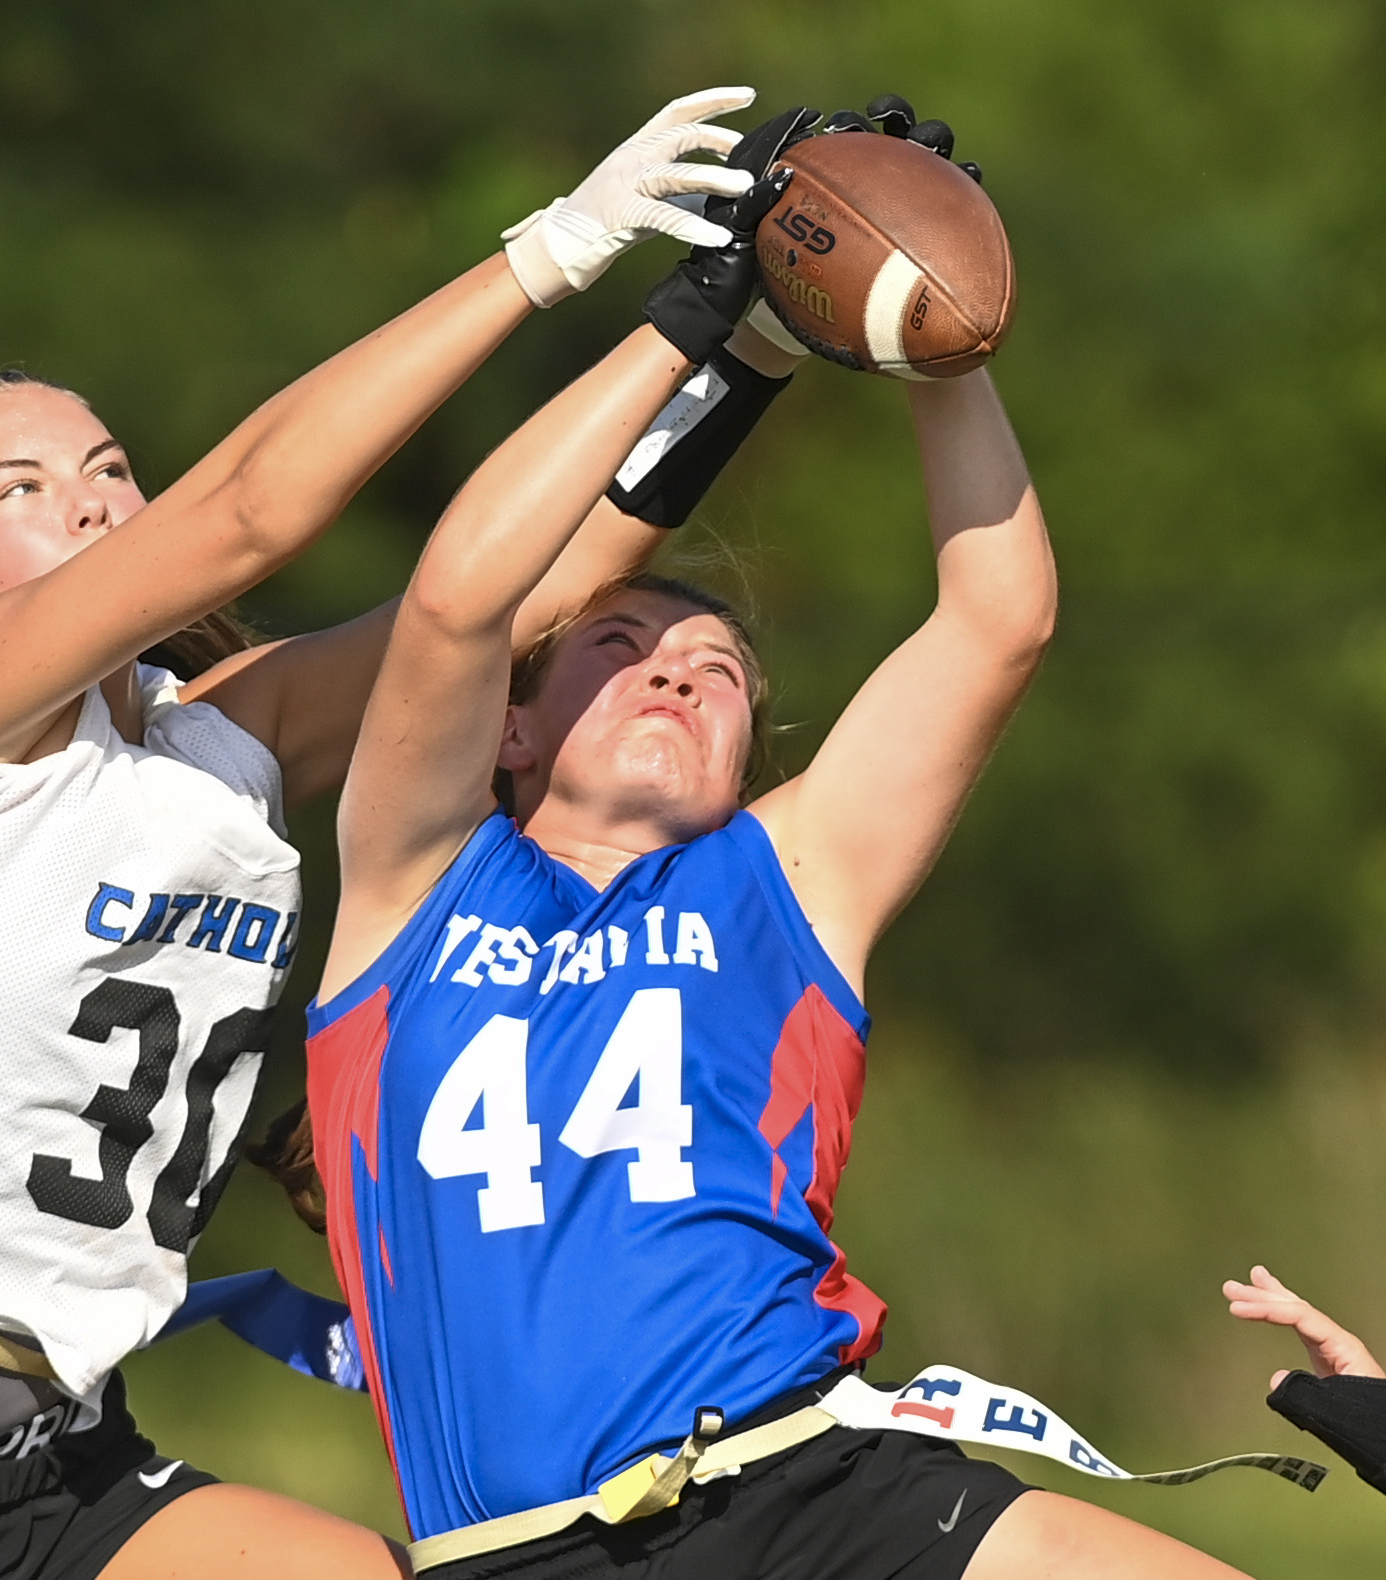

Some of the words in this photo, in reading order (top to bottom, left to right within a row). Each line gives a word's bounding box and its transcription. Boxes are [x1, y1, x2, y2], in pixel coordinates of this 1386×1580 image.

[774, 206, 835, 255] GST
[910, 285, 932, 331] GST
[26, 976, 278, 1253] 30
[417, 987, 696, 1233] 44
